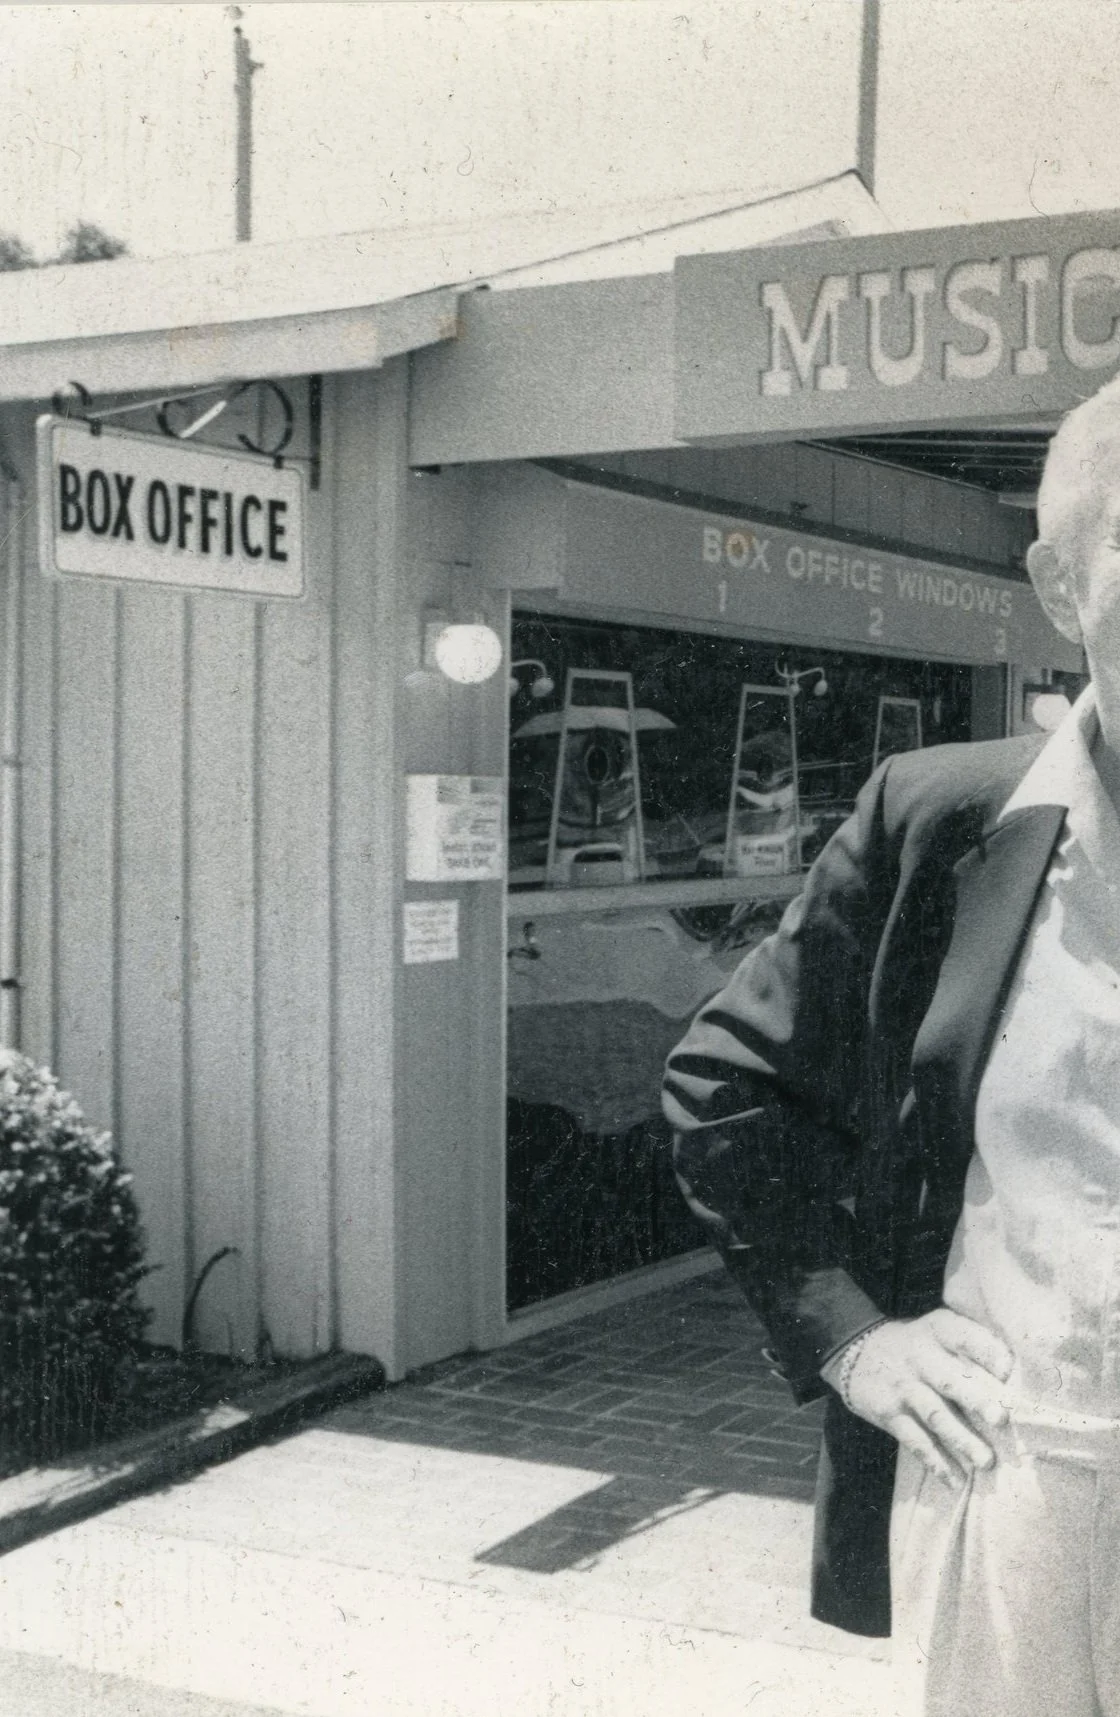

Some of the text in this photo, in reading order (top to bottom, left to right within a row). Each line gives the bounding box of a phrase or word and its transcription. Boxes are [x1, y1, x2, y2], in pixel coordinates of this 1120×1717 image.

[59, 463, 289, 562] BOX OFFICE
[702, 526, 1013, 618] BOX OFFICE WINDOWS
[717, 580, 1007, 655] 1 2 3
